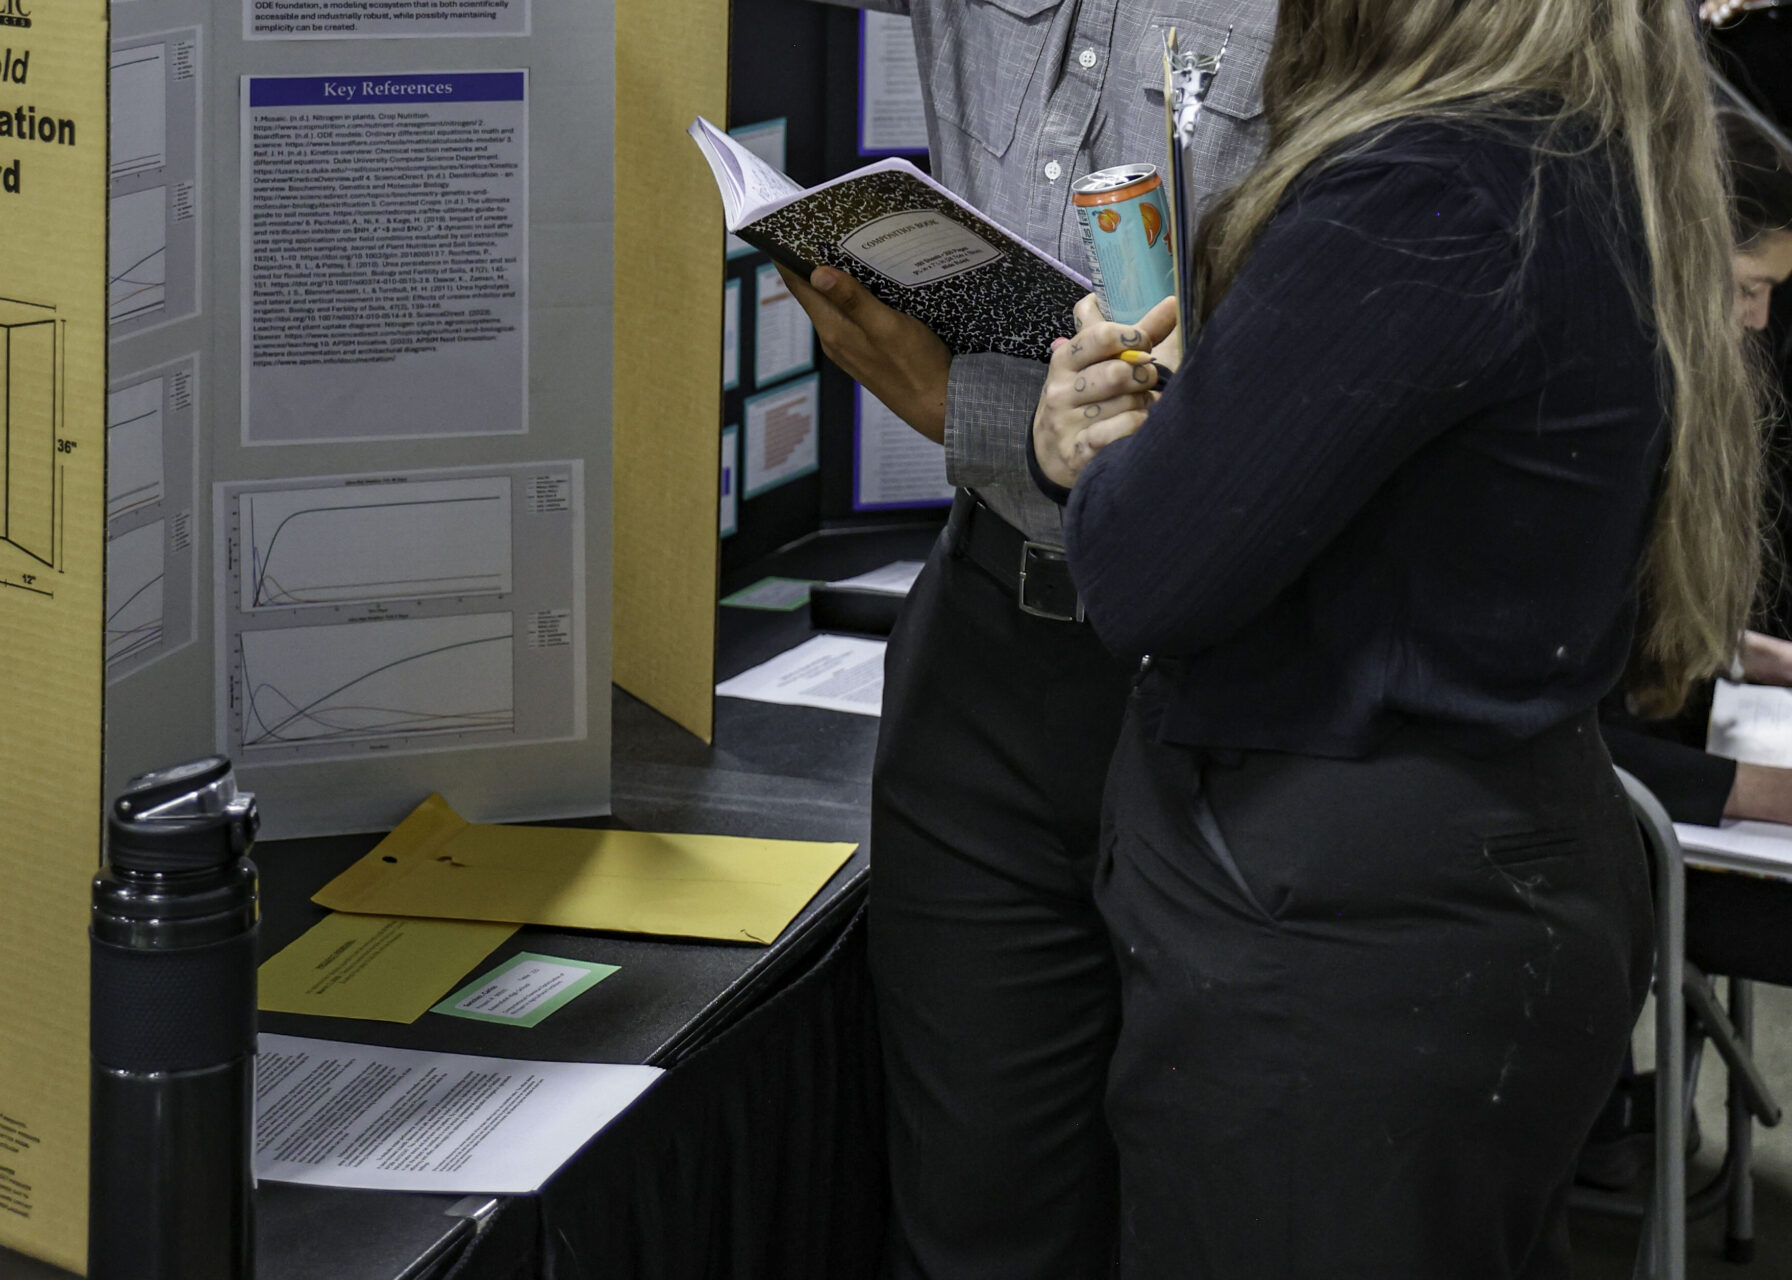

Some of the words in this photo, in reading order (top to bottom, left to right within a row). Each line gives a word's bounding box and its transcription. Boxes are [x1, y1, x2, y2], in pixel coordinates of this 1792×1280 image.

[0, 48, 30, 84] ld
[324, 82, 356, 100] Key
[362, 81, 453, 96] References
[0, 105, 76, 146] ation
[0, 159, 21, 194] d
[861, 225, 917, 250] COMPOSITION
[57, 439, 77, 454] 36"
[22, 574, 36, 585] 12"
